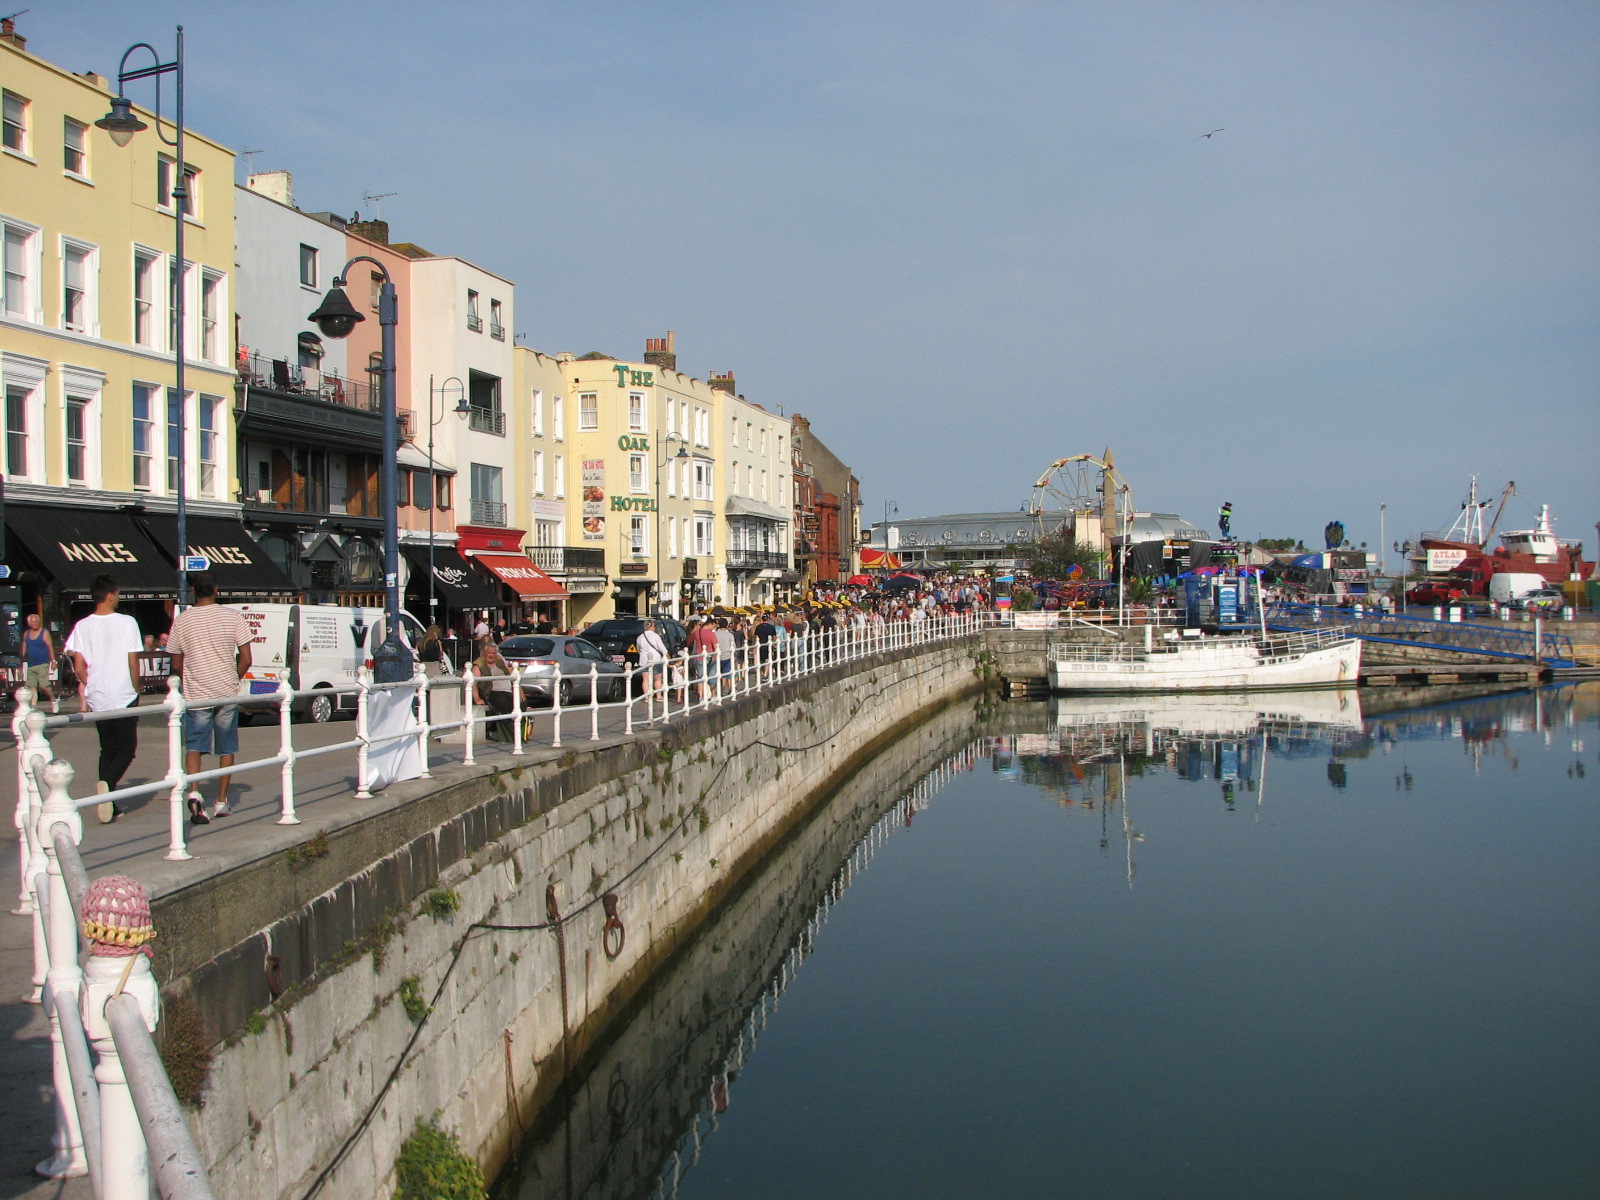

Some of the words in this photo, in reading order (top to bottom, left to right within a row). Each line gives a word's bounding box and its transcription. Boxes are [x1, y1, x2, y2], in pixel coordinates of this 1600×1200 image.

[613, 364, 654, 388] THE
[618, 435, 650, 451] OAK
[610, 496, 658, 512] HOTEL
[58, 541, 139, 563] MILES
[188, 545, 253, 564] MILES
[494, 567, 544, 577] ROKKA
[139, 657, 171, 677] ILES
